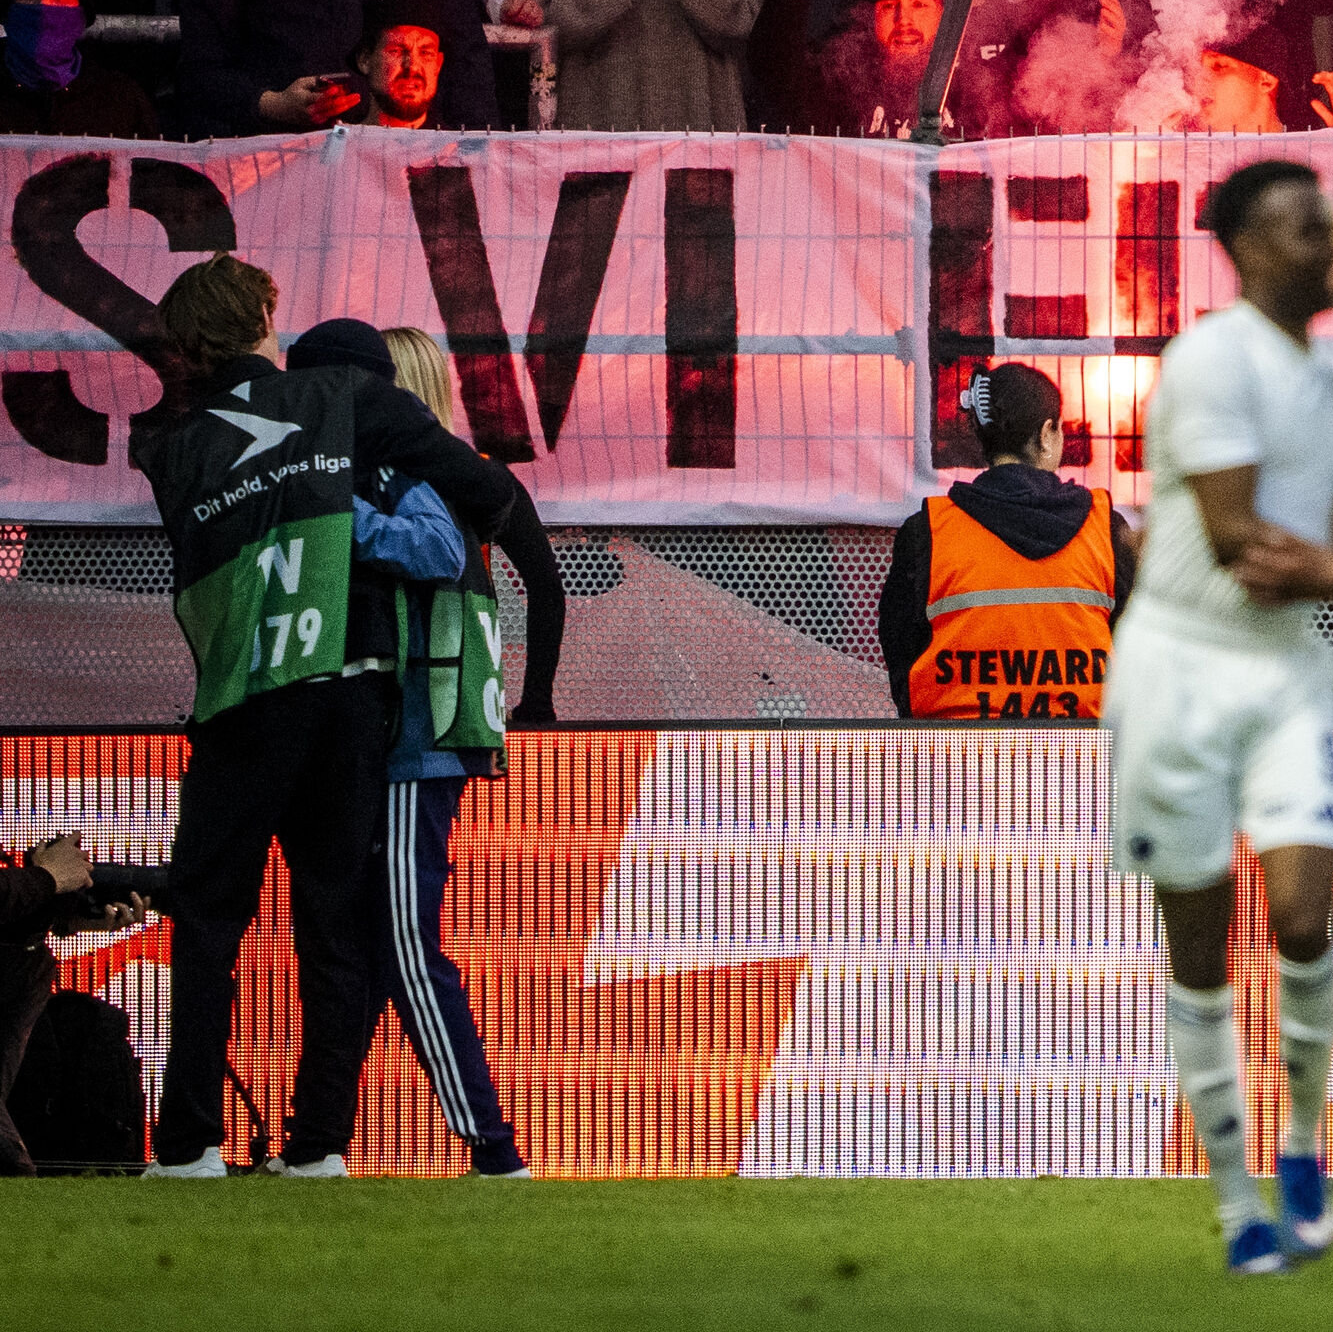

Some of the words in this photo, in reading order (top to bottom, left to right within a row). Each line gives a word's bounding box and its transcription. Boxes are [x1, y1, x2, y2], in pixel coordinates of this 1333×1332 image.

[408, 165, 738, 469] VI
[193, 498, 222, 522] Dit
[223, 475, 269, 506] hold.
[314, 454, 351, 473] liga
[935, 648, 1108, 686] STEWARD
[976, 691, 1080, 719] 1443
